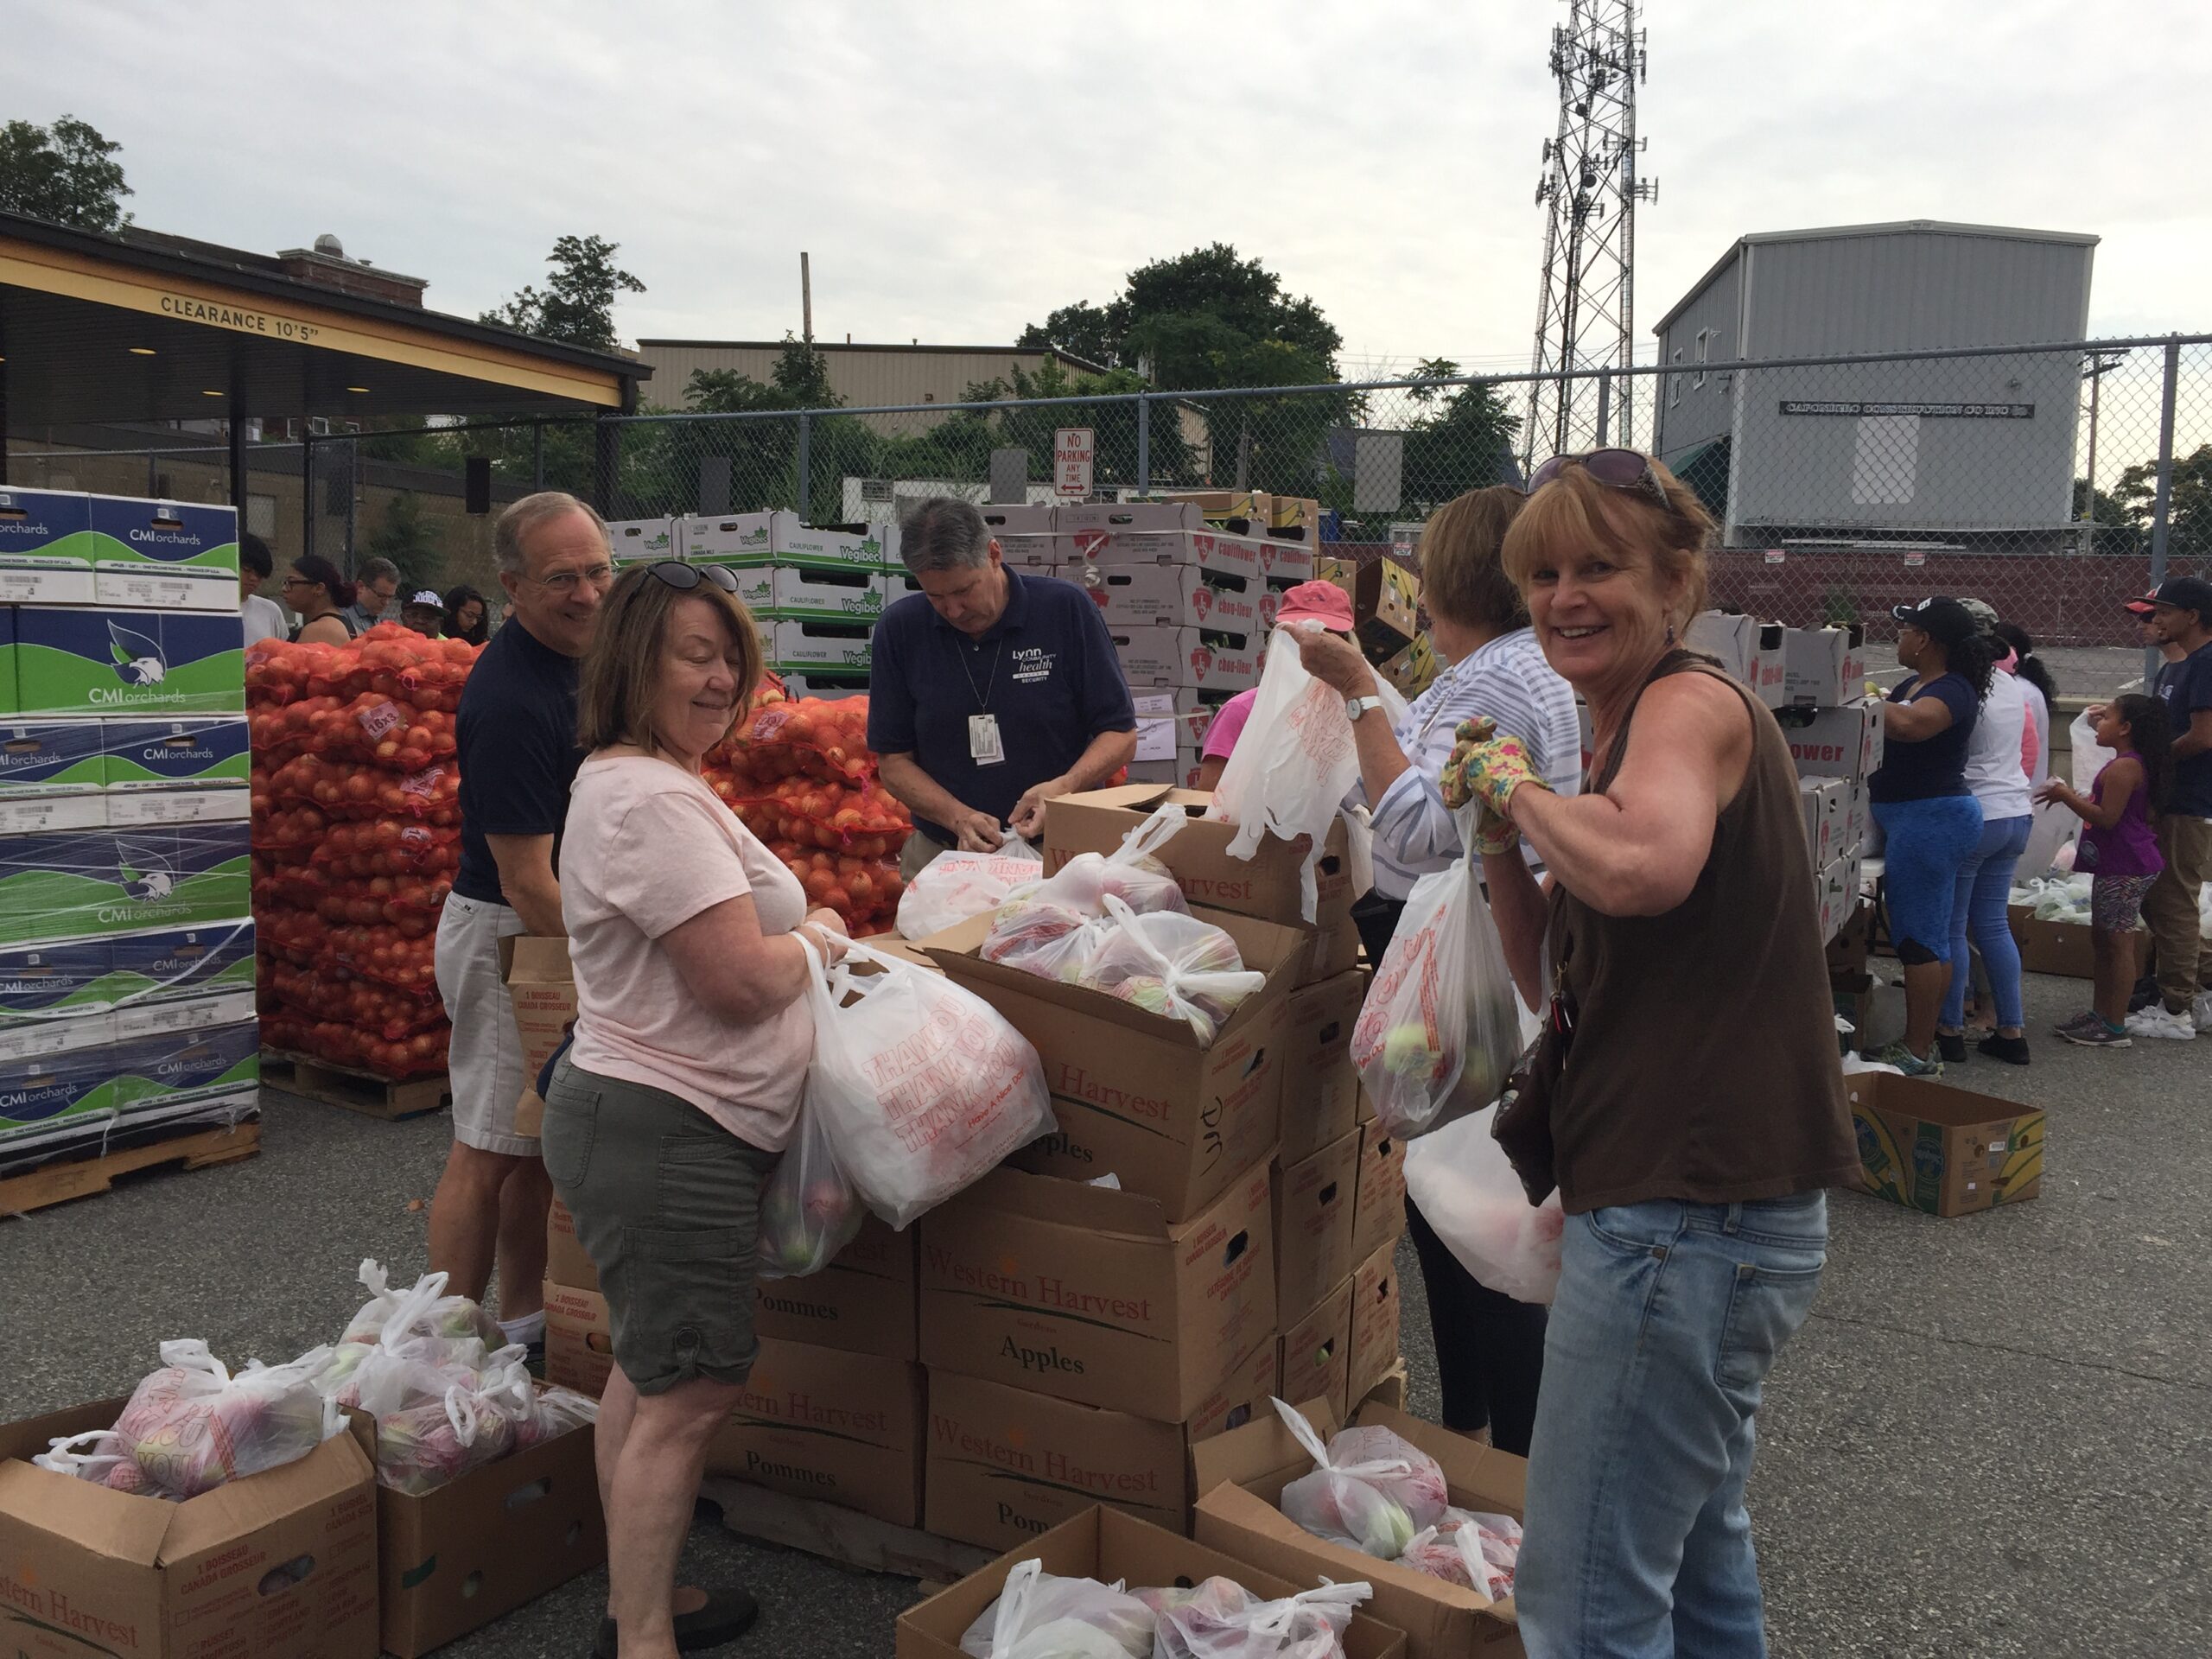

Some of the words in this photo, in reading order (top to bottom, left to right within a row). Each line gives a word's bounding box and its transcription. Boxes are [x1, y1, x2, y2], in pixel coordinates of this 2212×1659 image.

[161, 296, 265, 331] CLEARANCE
[1067, 435, 1081, 448] NO
[1057, 450, 1090, 462] PARKING
[1066, 464, 1080, 473] ANY
[1065, 474, 1081, 483] TIME
[0, 521, 48, 535] orchards
[156, 531, 201, 545] orchards
[740, 535, 768, 546] Vegibec
[789, 542, 823, 552] CAULIFLOWER
[840, 545, 880, 563] Vegibec
[1218, 542, 1256, 563] cauliflower
[742, 587, 772, 600] Vegibec
[790, 596, 825, 606] CAULIFLOWER
[842, 598, 883, 615] Vegibec
[792, 650, 827, 658] CAULIFLOWER
[842, 650, 872, 667] Vegib
[1013, 648, 1042, 661] Lynn
[1019, 659, 1052, 672] health
[125, 689, 186, 703] orchards
[368, 713, 397, 733] 16x3
[168, 747, 213, 760] orchards
[1790, 744, 1845, 762] ower
[1170, 865, 1253, 900] arvest
[861, 1022, 946, 1088] THANK
[930, 995, 967, 1033] OU
[877, 1048, 968, 1120] THANK
[954, 1014, 995, 1060] YOU
[29, 1082, 78, 1103] orchards
[894, 1079, 982, 1154] THANK
[977, 1037, 1016, 1089] YOU
[1058, 1062, 1173, 1122] Harvest
[967, 1109, 988, 1128] Have
[1034, 1132, 1093, 1164] ples
[926, 1244, 1027, 1300] Western
[1035, 1274, 1152, 1321] Harvest
[1000, 1335, 1085, 1375] Apples
[787, 1392, 887, 1432] Harvest
[933, 1414, 1035, 1473] Western
[1042, 1449, 1158, 1492] Harvest
[746, 1450, 836, 1487] Pommes
[995, 1500, 1050, 1535] Pom
[197, 1564, 202, 1574] 1
[206, 1543, 249, 1572] BOISSEAU
[181, 1573, 218, 1595] CANADA
[220, 1551, 267, 1580] GROSSEUR
[0, 1575, 43, 1615] stern
[48, 1589, 139, 1649] Harvest
